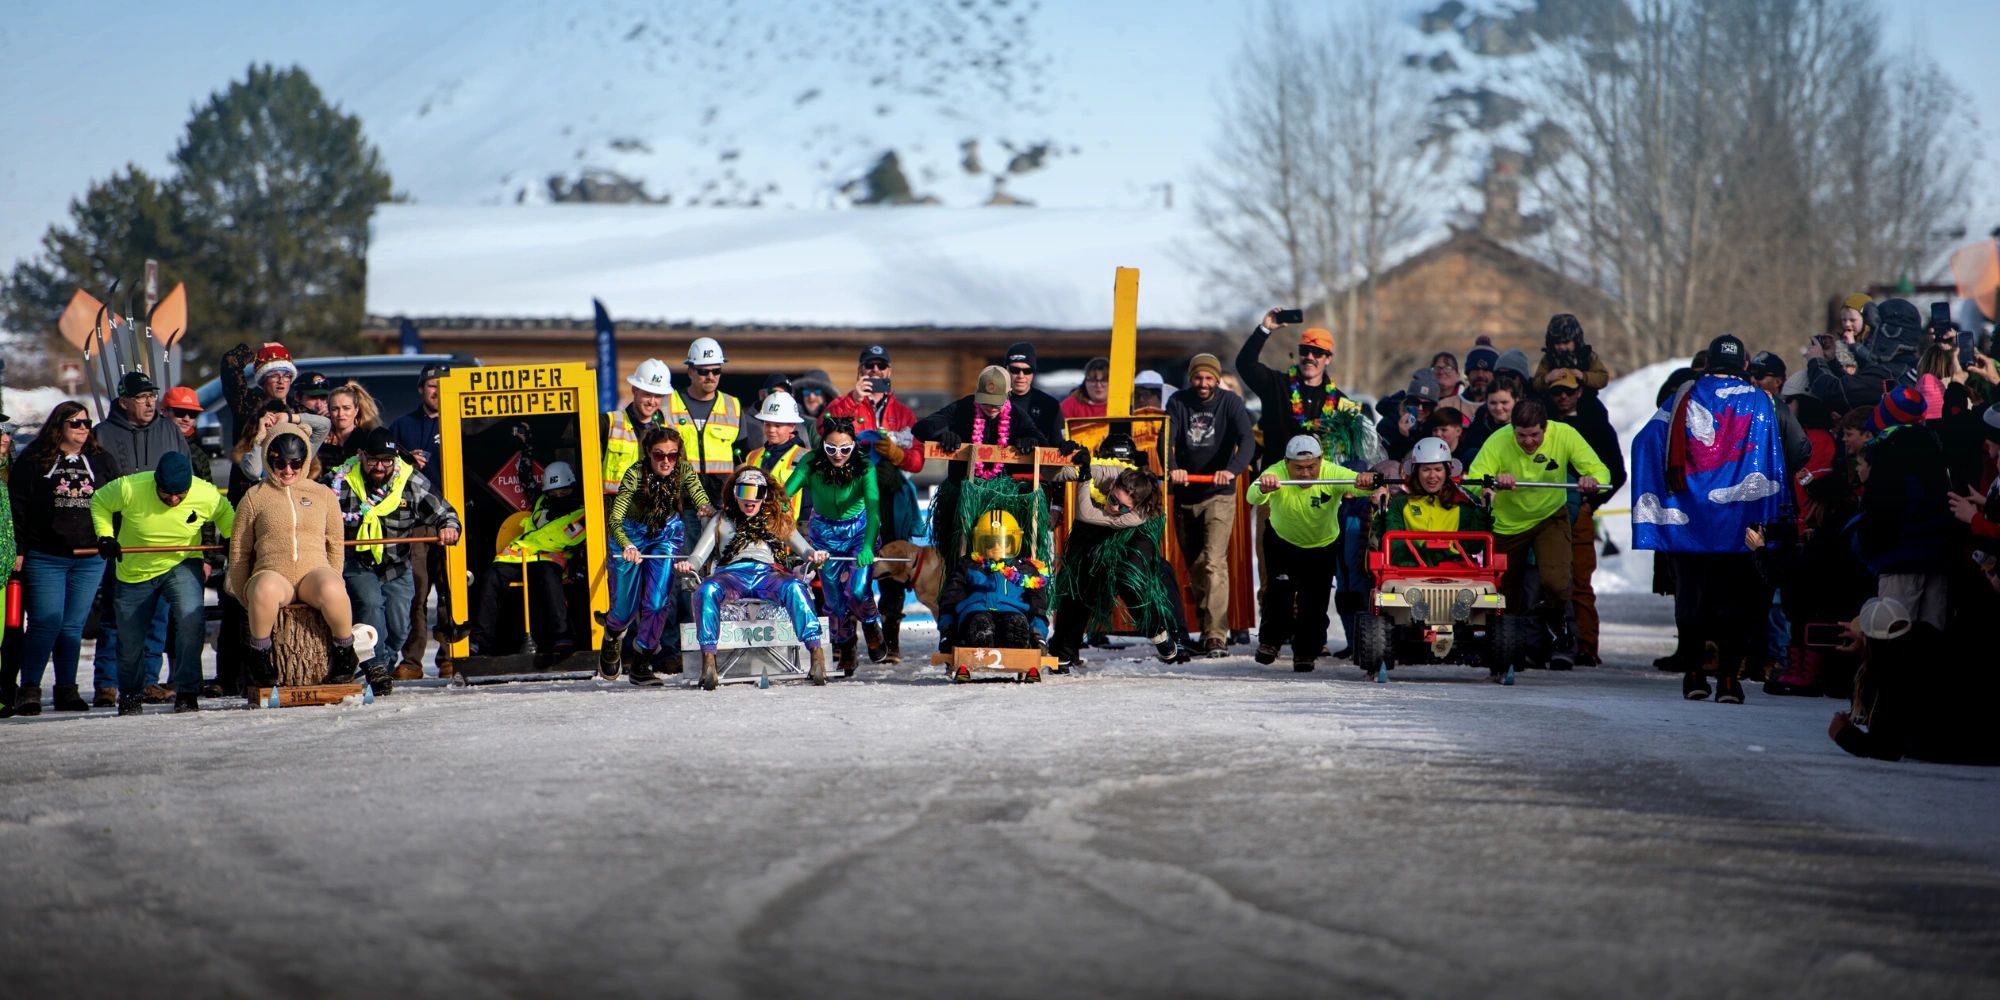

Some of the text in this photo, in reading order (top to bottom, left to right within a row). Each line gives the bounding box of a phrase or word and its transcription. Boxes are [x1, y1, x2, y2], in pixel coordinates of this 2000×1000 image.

[470, 368, 562, 390] POOPER
[464, 392, 572, 415] SCOOPER
[520, 500, 527, 508] 2
[721, 624, 775, 642] SPACE
